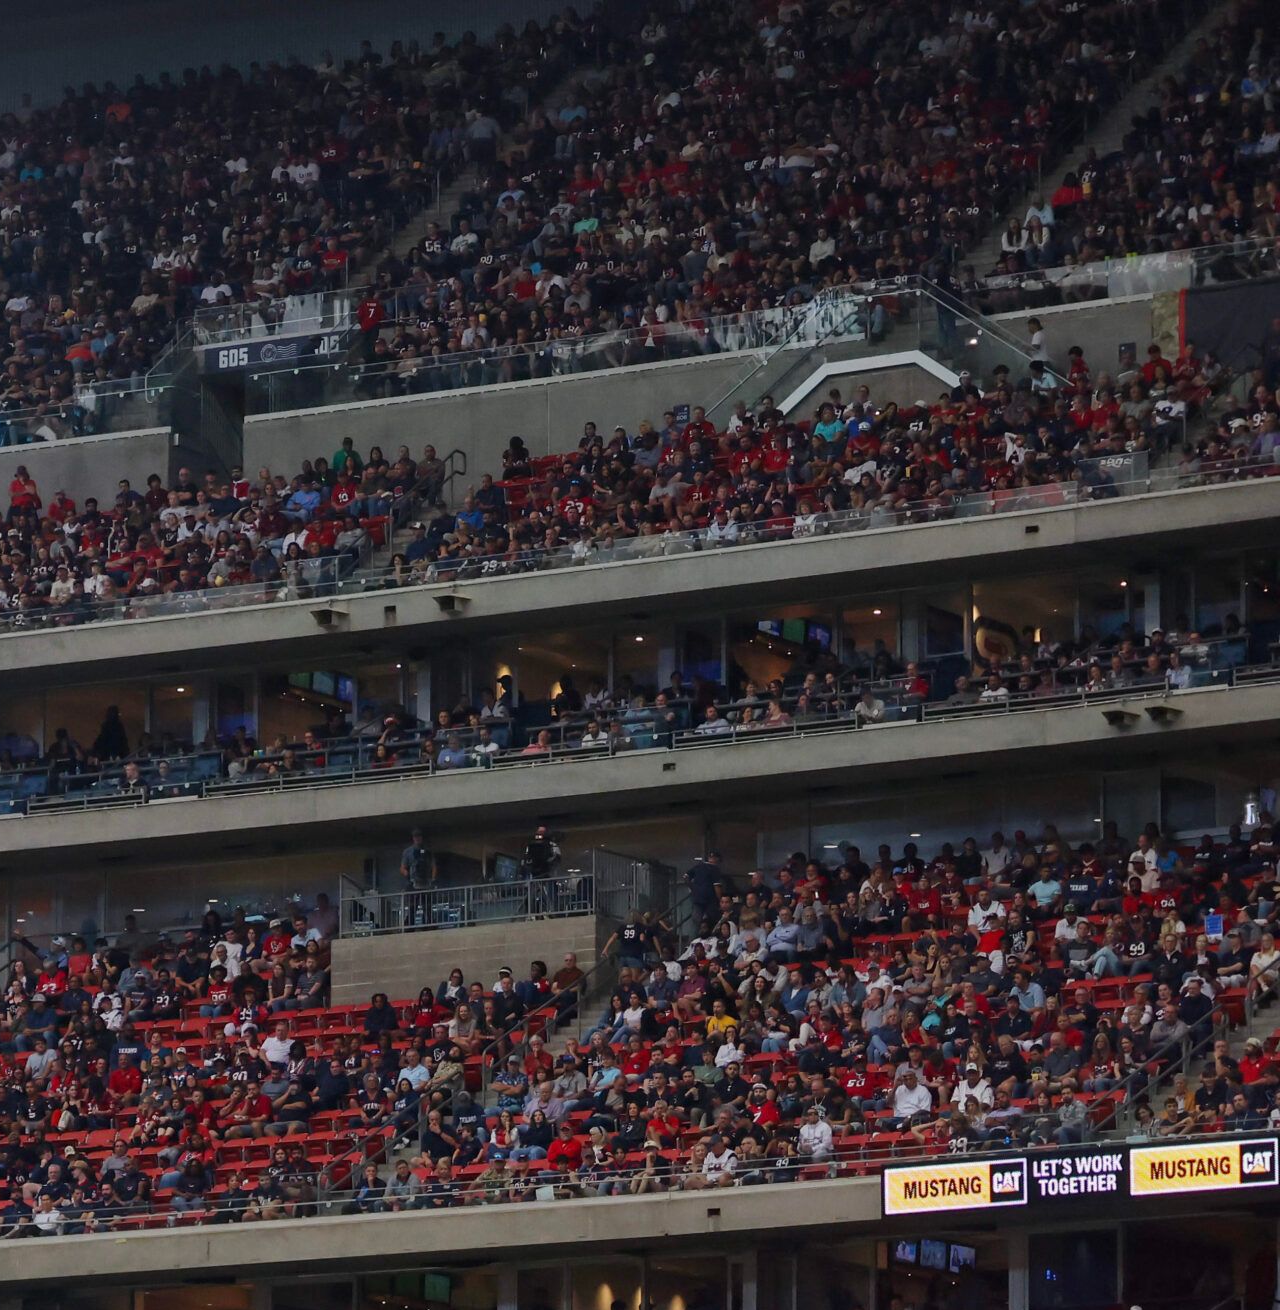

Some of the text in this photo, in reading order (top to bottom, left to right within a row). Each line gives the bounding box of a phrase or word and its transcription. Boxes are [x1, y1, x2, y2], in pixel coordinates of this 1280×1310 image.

[368, 308, 375, 318] 7
[219, 347, 249, 369] 605
[624, 929, 635, 939] 99
[1130, 942, 1145, 957] 99
[1033, 1153, 1123, 1178] LET'S WORK
[1150, 1156, 1230, 1181] MUSTANG
[1242, 1149, 1272, 1174] CAT
[903, 1176, 982, 1200] MUSTANG
[992, 1170, 1023, 1193] CAT
[1038, 1174, 1117, 1196] TOGETHER
